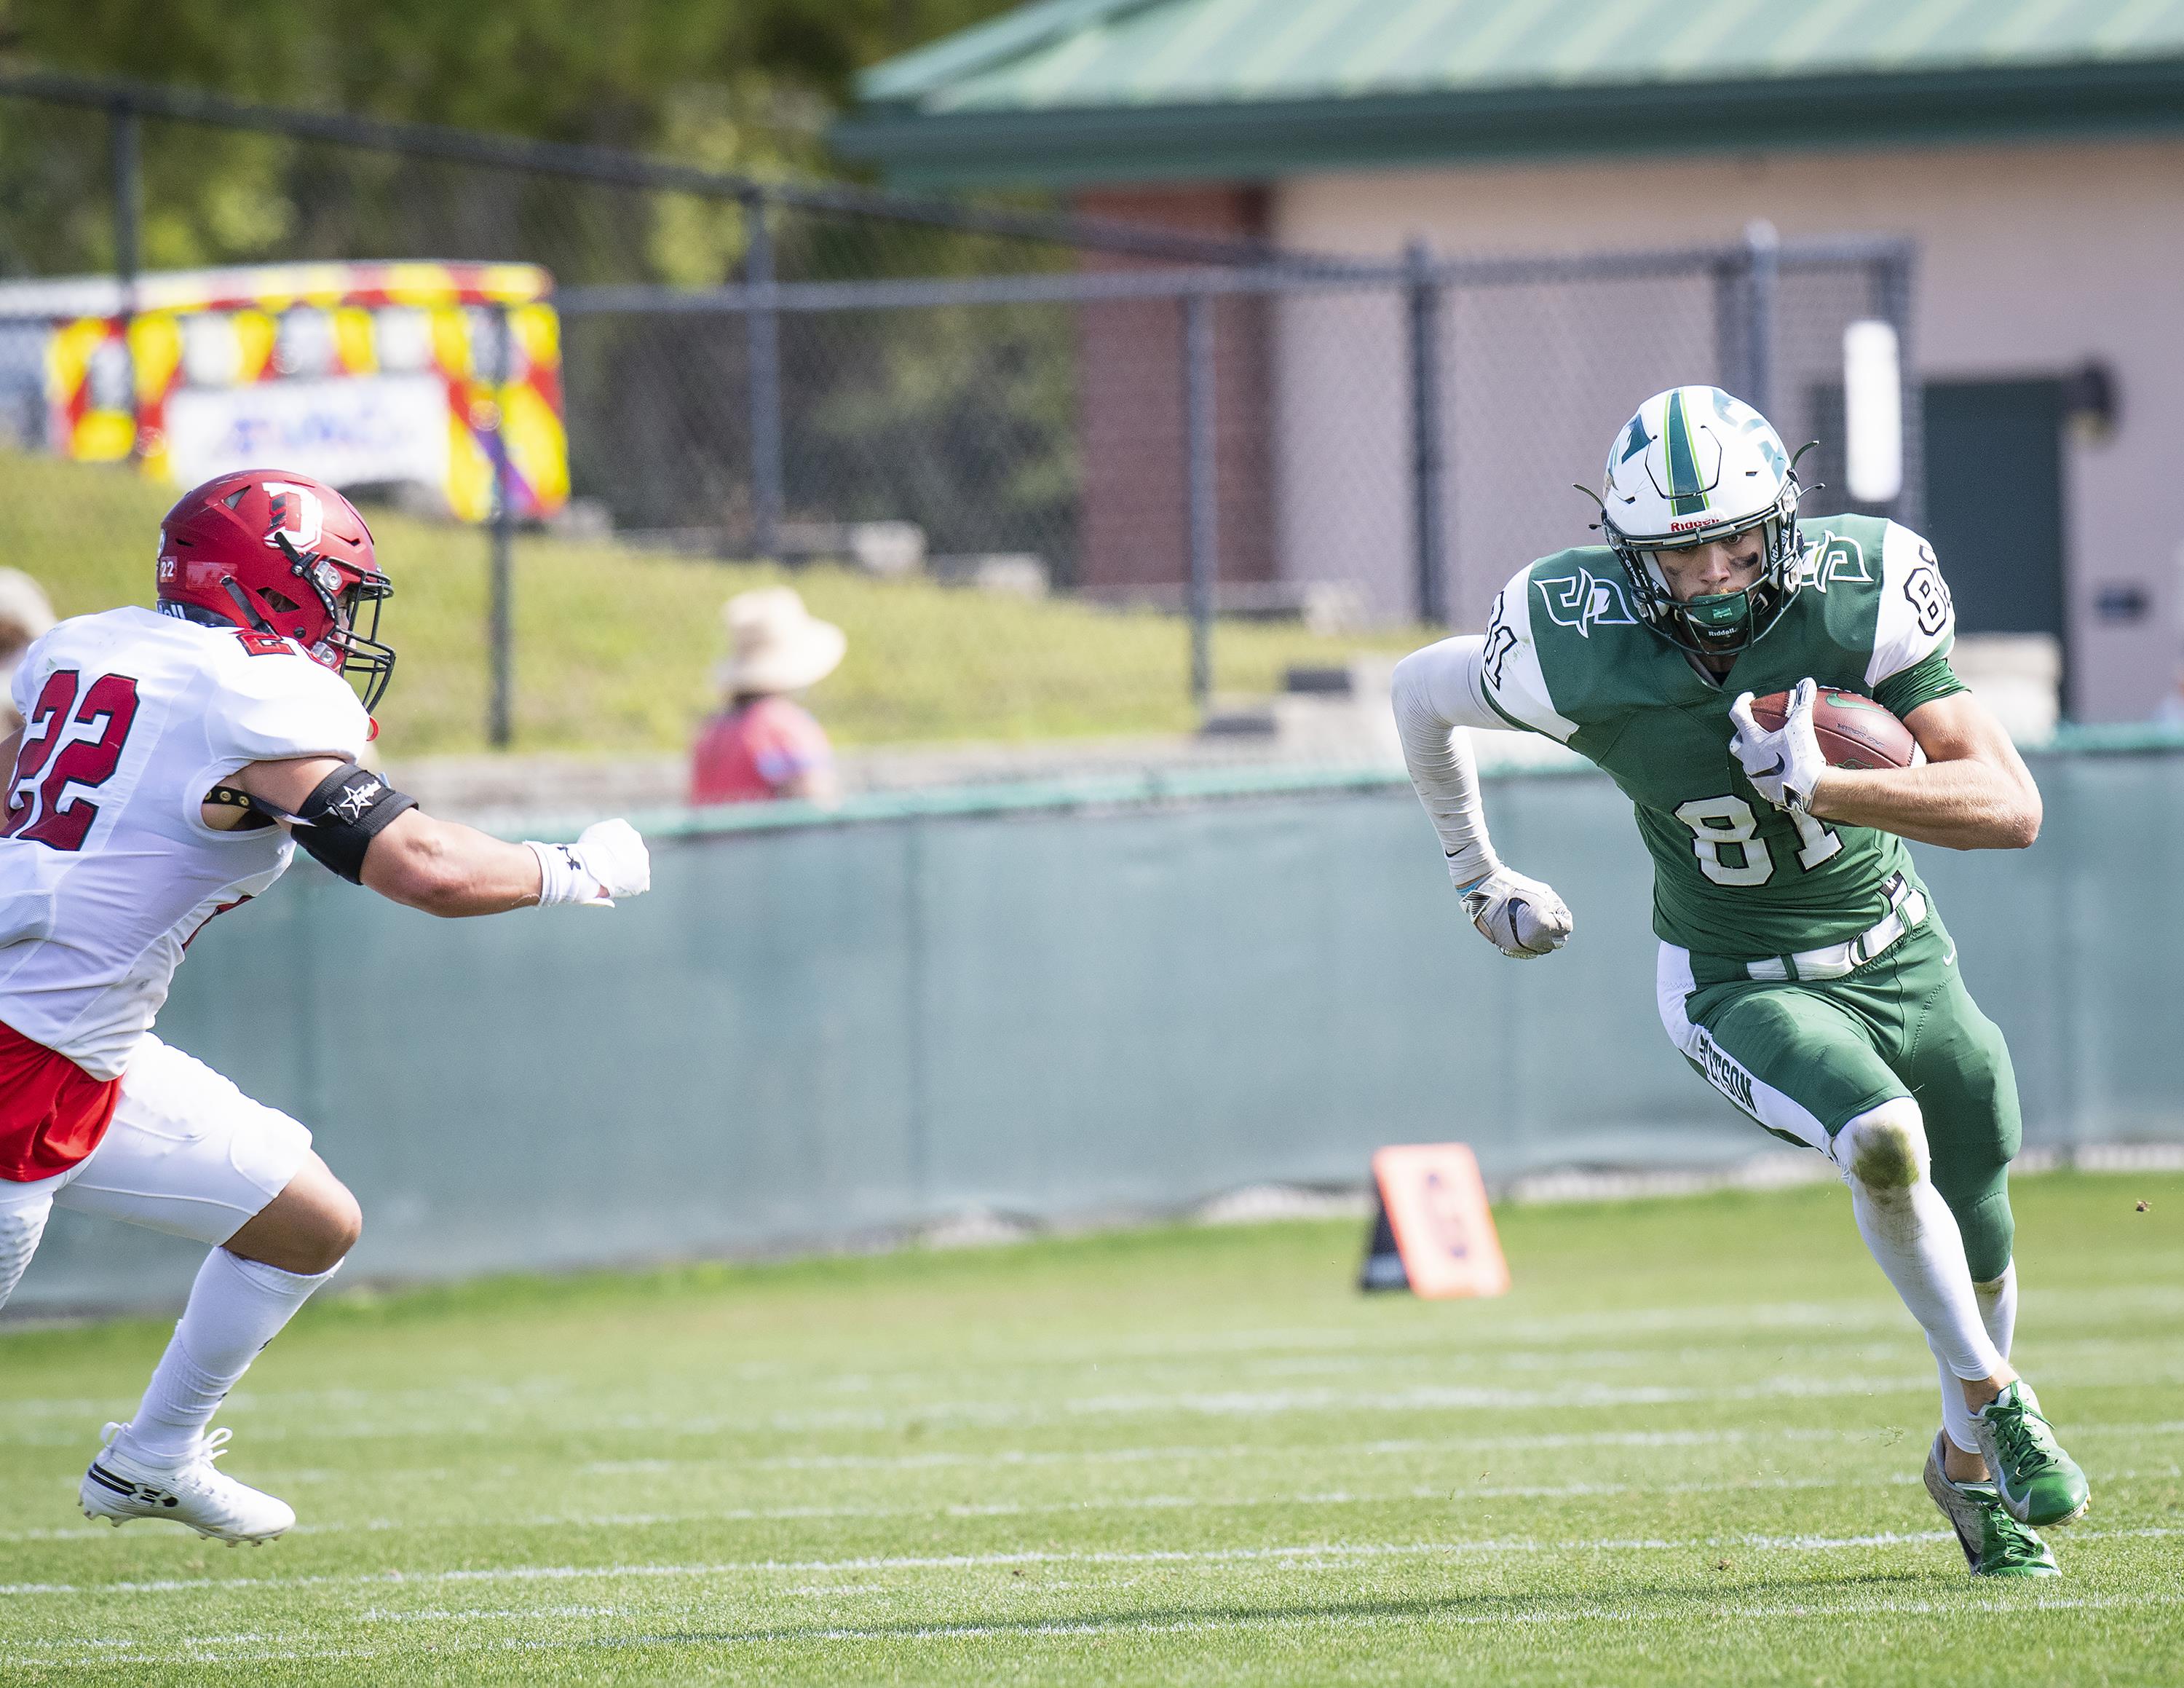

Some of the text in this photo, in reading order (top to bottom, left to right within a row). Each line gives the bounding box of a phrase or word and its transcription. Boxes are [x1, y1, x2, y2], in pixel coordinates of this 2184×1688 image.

[1671, 518, 1720, 532] Ridde
[1770, 528, 1791, 566] idell
[161, 561, 174, 577] 22
[0, 669, 141, 852] 22
[1671, 792, 1846, 888] 81
[1884, 875, 1898, 891] M
